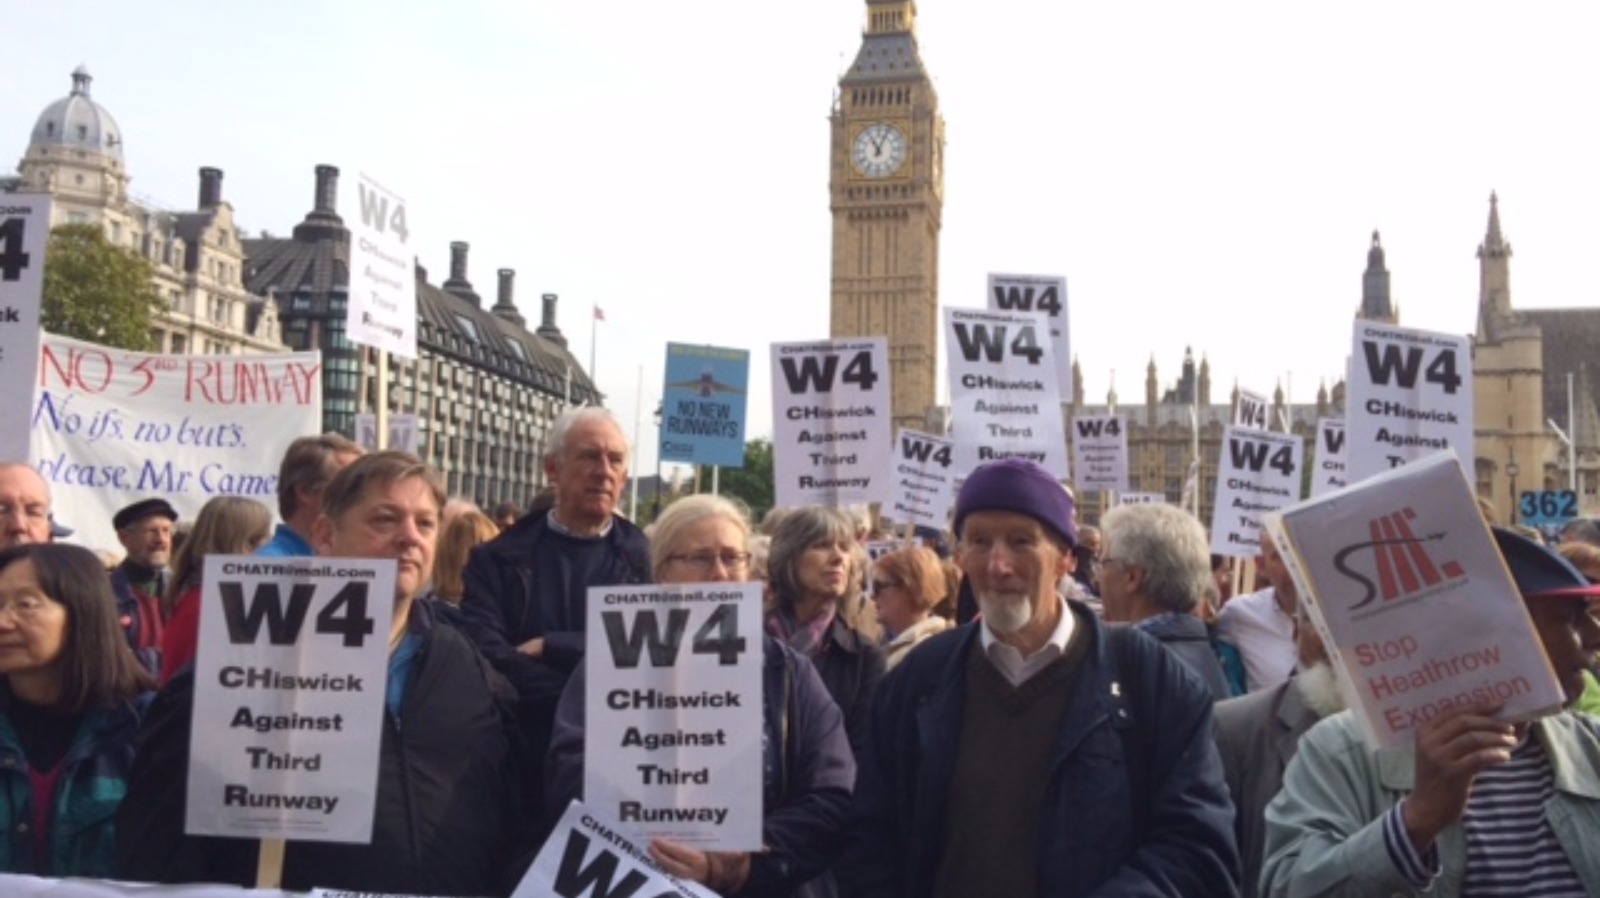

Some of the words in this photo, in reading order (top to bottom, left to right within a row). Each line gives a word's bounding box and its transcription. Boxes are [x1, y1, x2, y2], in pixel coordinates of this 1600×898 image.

[358, 182, 409, 244] W4
[0, 218, 30, 281] 4
[994, 285, 1062, 317] W4
[953, 322, 1043, 365] W4
[42, 344, 113, 394] NO
[184, 358, 321, 405] RUNWAY
[780, 351, 878, 394] W4
[1362, 341, 1461, 394] W4
[962, 374, 1044, 391] CHiswick
[32, 391, 82, 434] No
[134, 421, 171, 443] no
[677, 399, 697, 418] NO
[700, 401, 731, 421] NEW
[786, 405, 876, 421] CHiswick
[974, 399, 1038, 415] Against
[1240, 398, 1266, 430] W4
[1366, 399, 1459, 425] CHiswick
[667, 416, 739, 439] RUNWAYS
[797, 430, 868, 444] Against
[987, 424, 1032, 438] Third
[1077, 417, 1121, 438] W4
[1375, 427, 1448, 449] Against
[810, 453, 858, 466] Third
[902, 437, 953, 469] W4
[1229, 438, 1295, 477] W4
[200, 463, 280, 496] Came
[799, 476, 870, 489] Runway
[1520, 490, 1578, 518] 362
[218, 580, 374, 648] W4
[602, 603, 746, 669] W4
[1355, 633, 1419, 668] Stop
[218, 666, 364, 692] CHiswick
[1369, 644, 1502, 700] Heathrow
[607, 689, 742, 710] CHiswick
[230, 706, 344, 732] Against
[620, 726, 727, 751] Against
[246, 747, 322, 772] Third
[637, 764, 709, 785] Third
[224, 784, 339, 814] Runway
[619, 801, 729, 825] Runway
